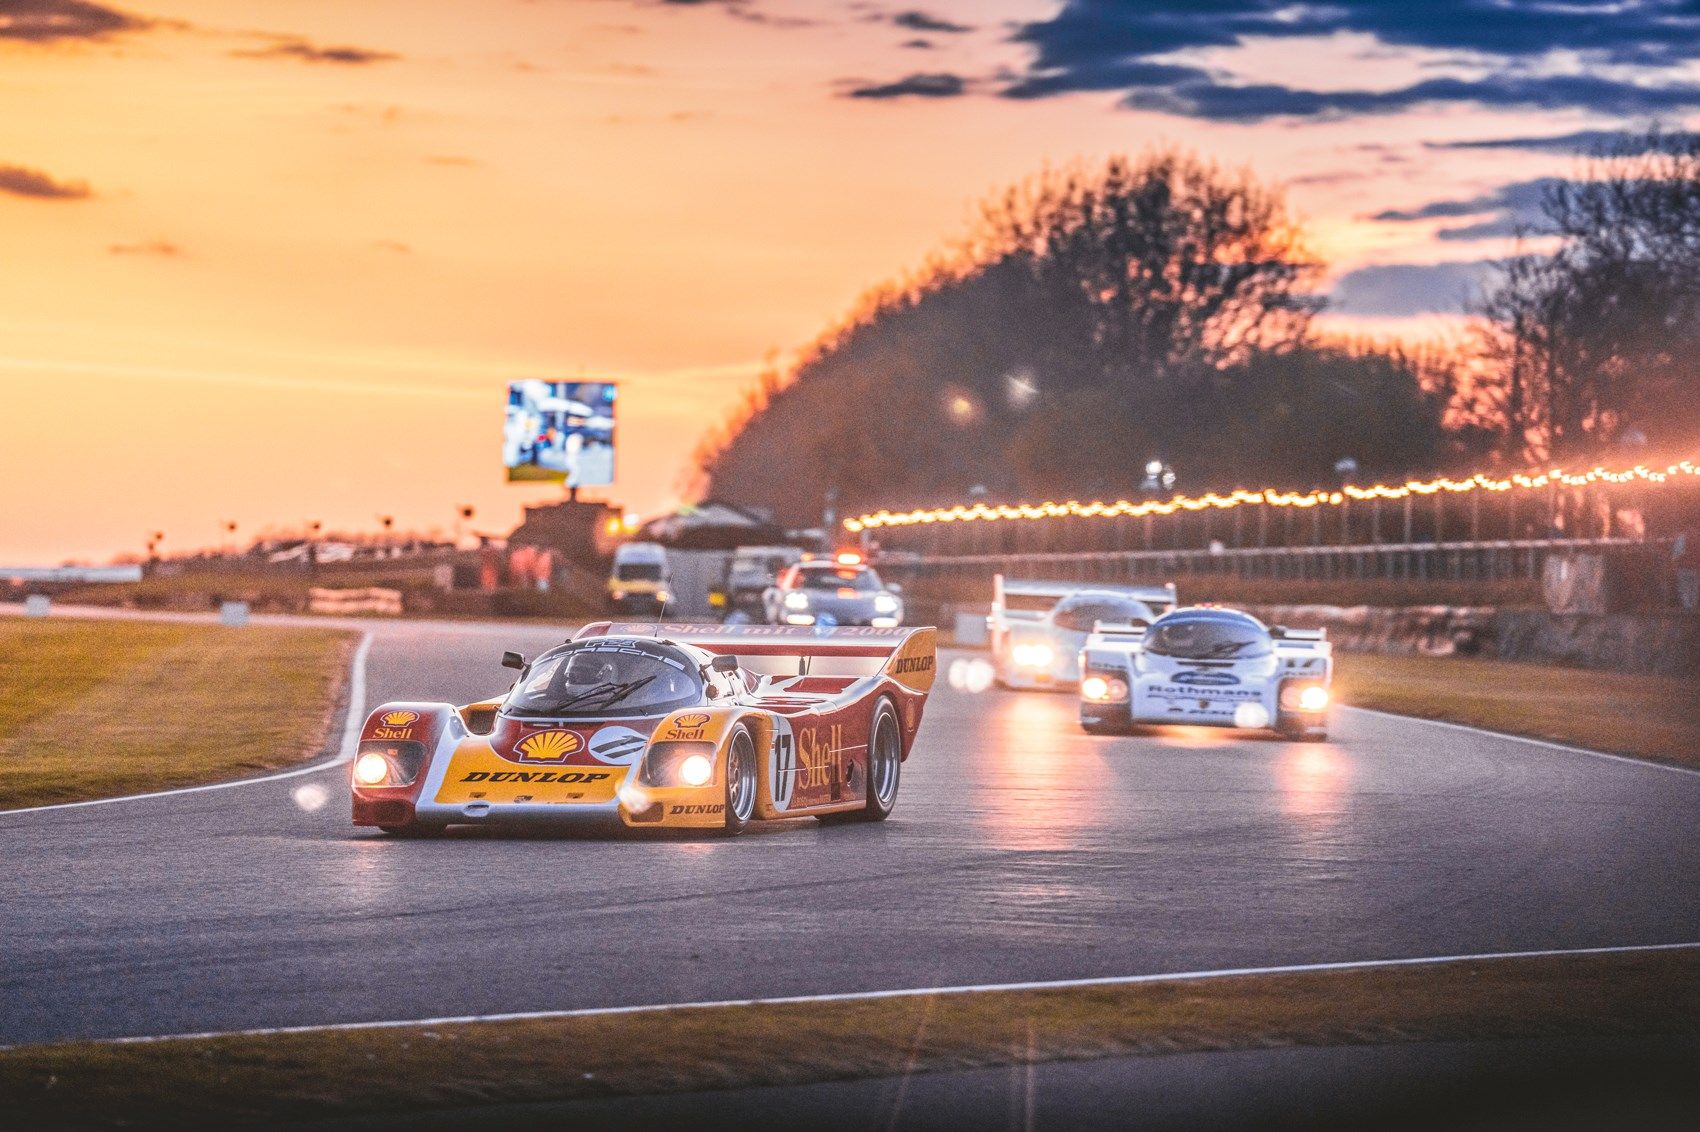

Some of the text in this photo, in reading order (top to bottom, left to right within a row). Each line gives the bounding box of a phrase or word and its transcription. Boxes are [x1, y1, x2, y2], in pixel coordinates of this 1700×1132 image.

[660, 624, 735, 634] Shell
[743, 626, 799, 635] mit
[895, 656, 934, 674] DUNLOP
[1148, 685, 1263, 697] Rothmans
[372, 727, 413, 739] Shell
[665, 729, 705, 740] Shell
[798, 724, 843, 790] Shell
[774, 733, 792, 802] 17
[459, 771, 611, 784] DUNLOP
[669, 804, 726, 815] DUNLOP
